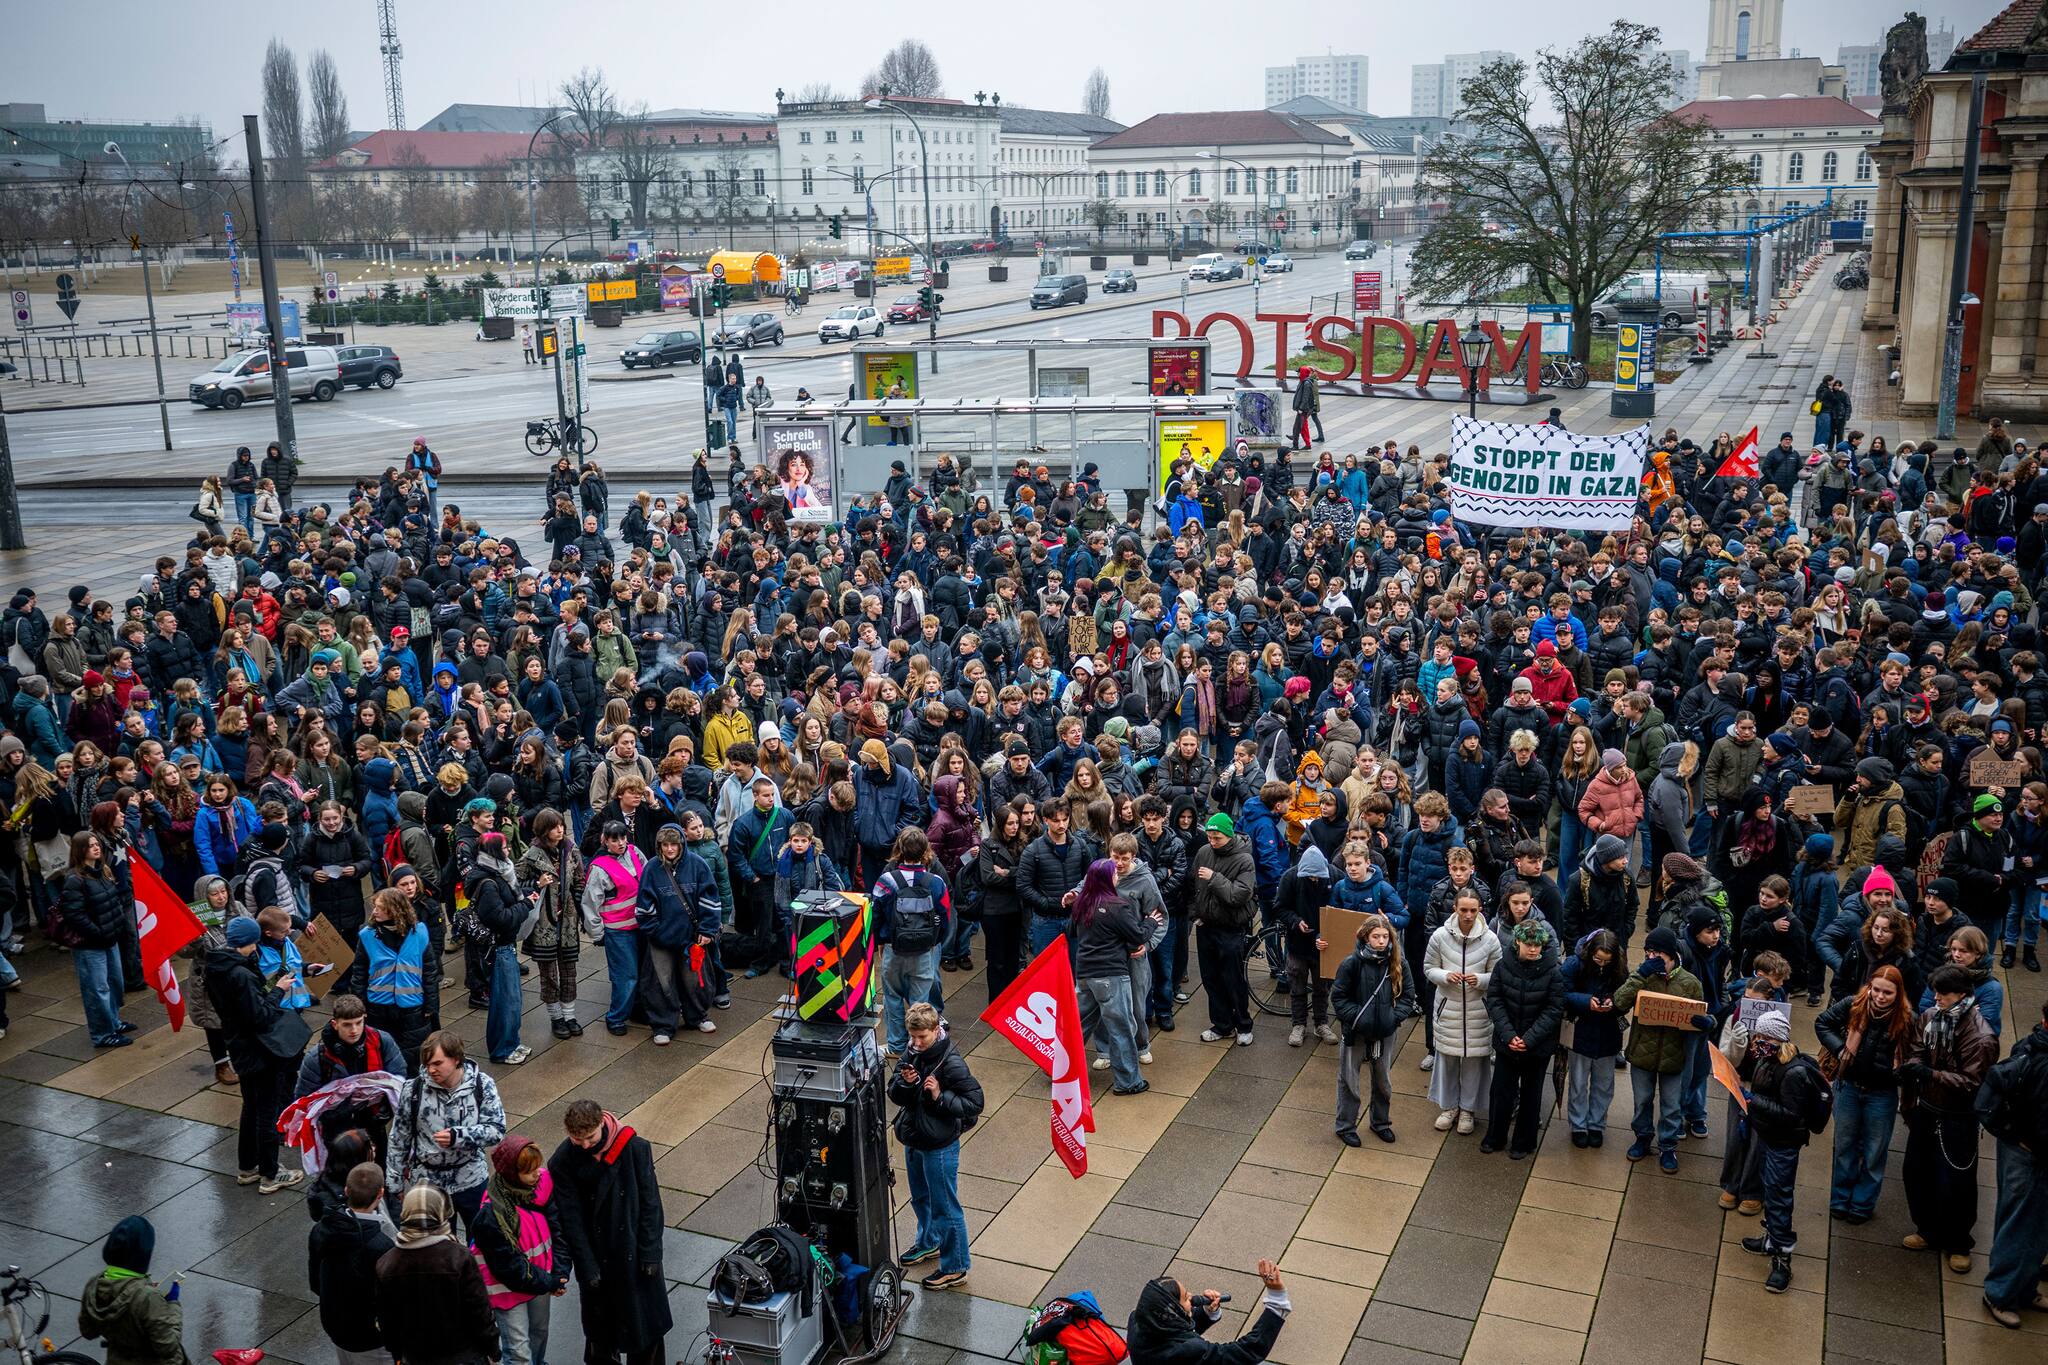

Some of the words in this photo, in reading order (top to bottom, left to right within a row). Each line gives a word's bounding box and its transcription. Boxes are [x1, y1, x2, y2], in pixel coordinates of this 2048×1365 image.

[494, 304, 537, 315] Tannenho
[773, 428, 815, 443] Schreib
[777, 442, 793, 450] Dein
[793, 440, 822, 452] Buch!
[1473, 444, 1561, 470] STOPPT
[1569, 451, 1616, 473] DEN
[1450, 462, 1540, 495] GENOZID
[1549, 475, 1572, 496] IN
[1580, 476, 1637, 497] GAZA
[1071, 616, 1095, 626] MAKE
[1071, 624, 1095, 636] LOVE
[1074, 634, 1093, 643] NOT
[1984, 768, 2009, 777] GEGEN
[1971, 776, 2020, 785] WEHRPFLICHT
[1752, 1001, 1777, 1012] KEIN
[1641, 1007, 1692, 1026] SCHIEßE
